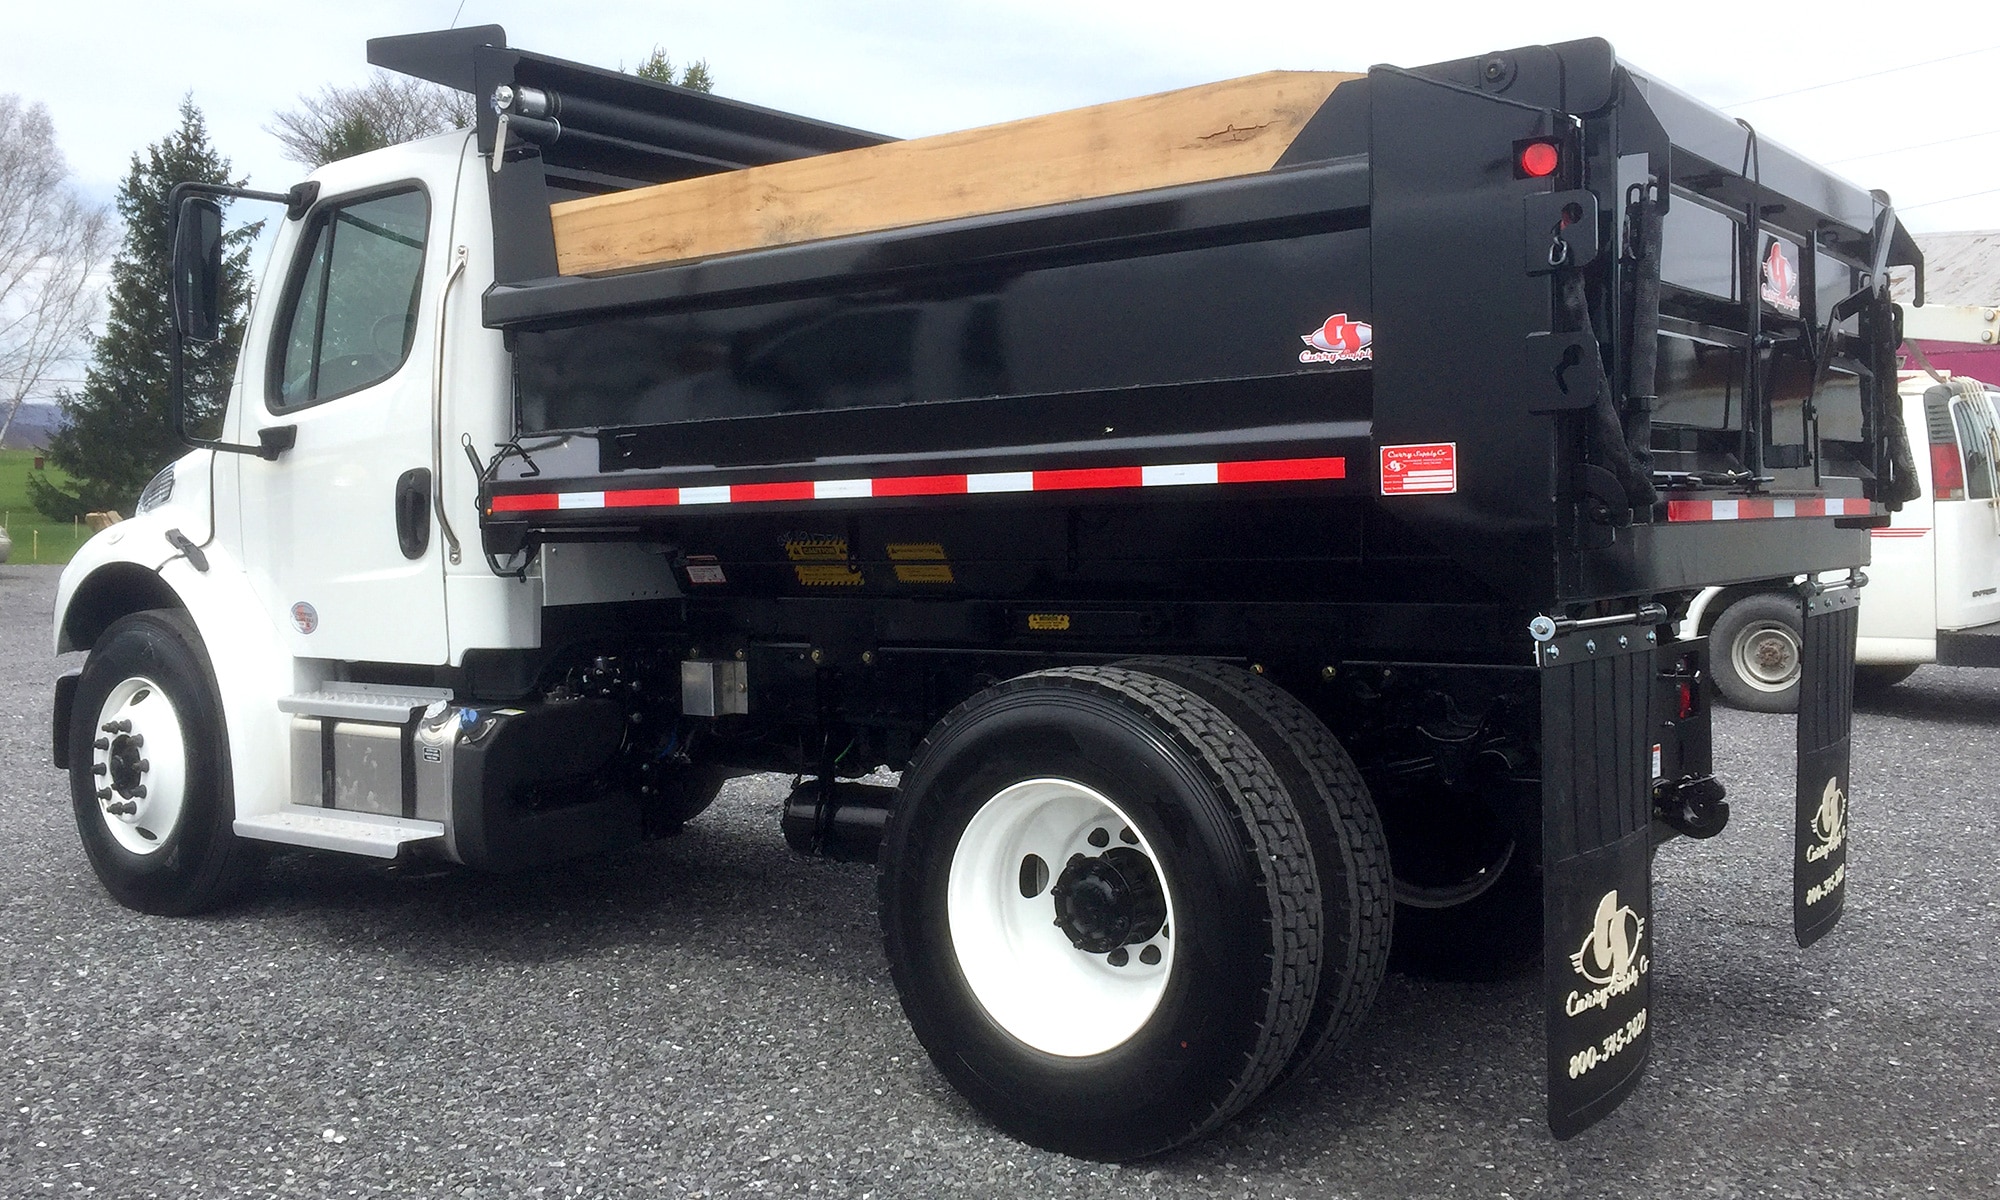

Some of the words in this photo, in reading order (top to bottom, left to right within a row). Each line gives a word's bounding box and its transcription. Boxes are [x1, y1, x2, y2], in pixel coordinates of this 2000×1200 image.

[1299, 350, 1338, 364] Curry
[1387, 450, 1412, 459] Curry
[1413, 449, 1438, 458] Supply
[1566, 984, 1611, 1018] Curry
